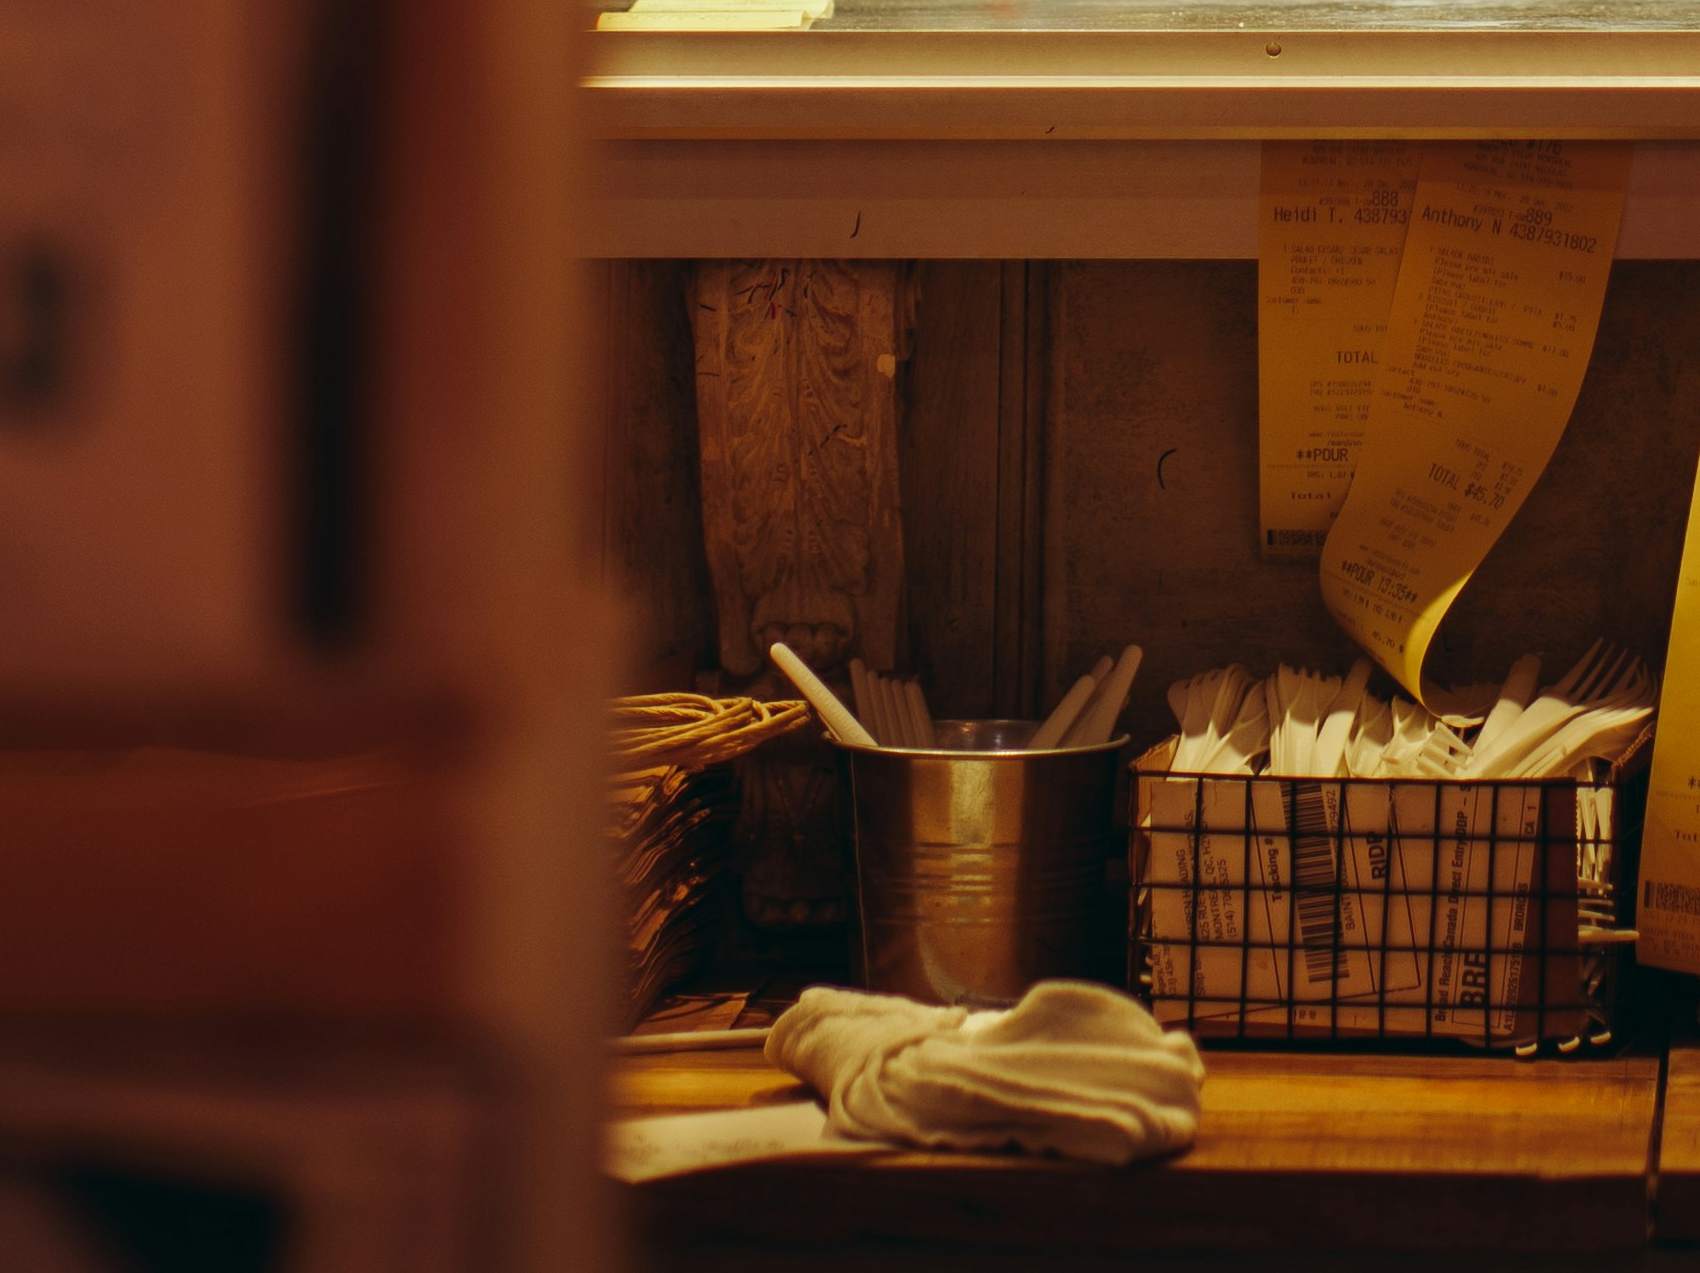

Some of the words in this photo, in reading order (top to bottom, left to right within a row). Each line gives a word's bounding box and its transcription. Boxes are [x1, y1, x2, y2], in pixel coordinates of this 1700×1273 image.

[1372, 191, 1398, 206] 888
[1274, 206, 1317, 222] Heidi
[1329, 208, 1343, 223] T.
[1354, 208, 1411, 223] 438793
[1526, 208, 1552, 226] 889
[1421, 206, 1482, 233] Anthony
[1492, 219, 1501, 235] N
[1510, 223, 1596, 253] 4387931802
[1336, 351, 1379, 364] TOTAL
[1428, 462, 1461, 490] TOTAL
[1465, 482, 1505, 509] $45.70
[1455, 811, 1468, 836] DDP
[1524, 822, 1534, 834] CA
[1176, 850, 1191, 898] HADING
[1448, 872, 1462, 904] Drect
[1197, 899, 1207, 920] RUE
[1224, 910, 1238, 937] (514)
[1442, 908, 1458, 949] Canada
[1434, 990, 1448, 1022] Brad
